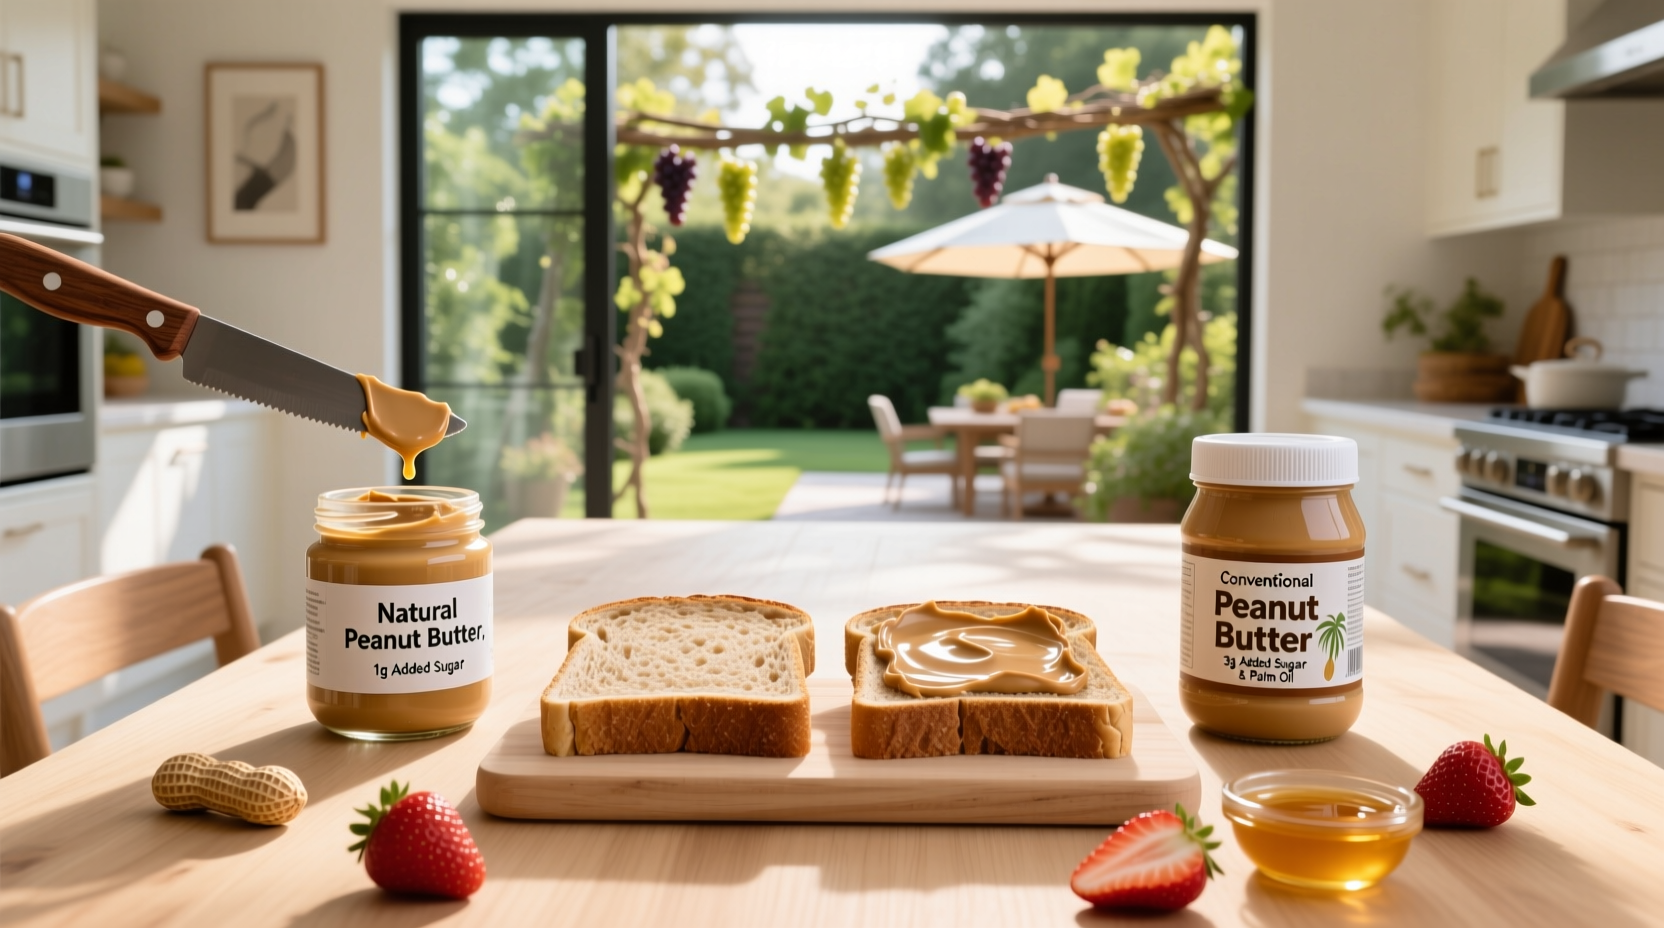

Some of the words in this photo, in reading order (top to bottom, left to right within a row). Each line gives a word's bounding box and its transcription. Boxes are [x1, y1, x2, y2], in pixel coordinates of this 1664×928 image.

[1220, 570, 1314, 588] Conventional
[377, 597, 458, 624] Natural
[1214, 589, 1319, 621] Peanut
[344, 627, 422, 650] Peanut
[1214, 620, 1313, 653] Butter
[373, 663, 388, 679] 1g
[390, 660, 431, 677] Added
[433, 659, 465, 676] Sugar
[1249, 670, 1277, 682] Palm
[1279, 668, 1295, 683] Oil
